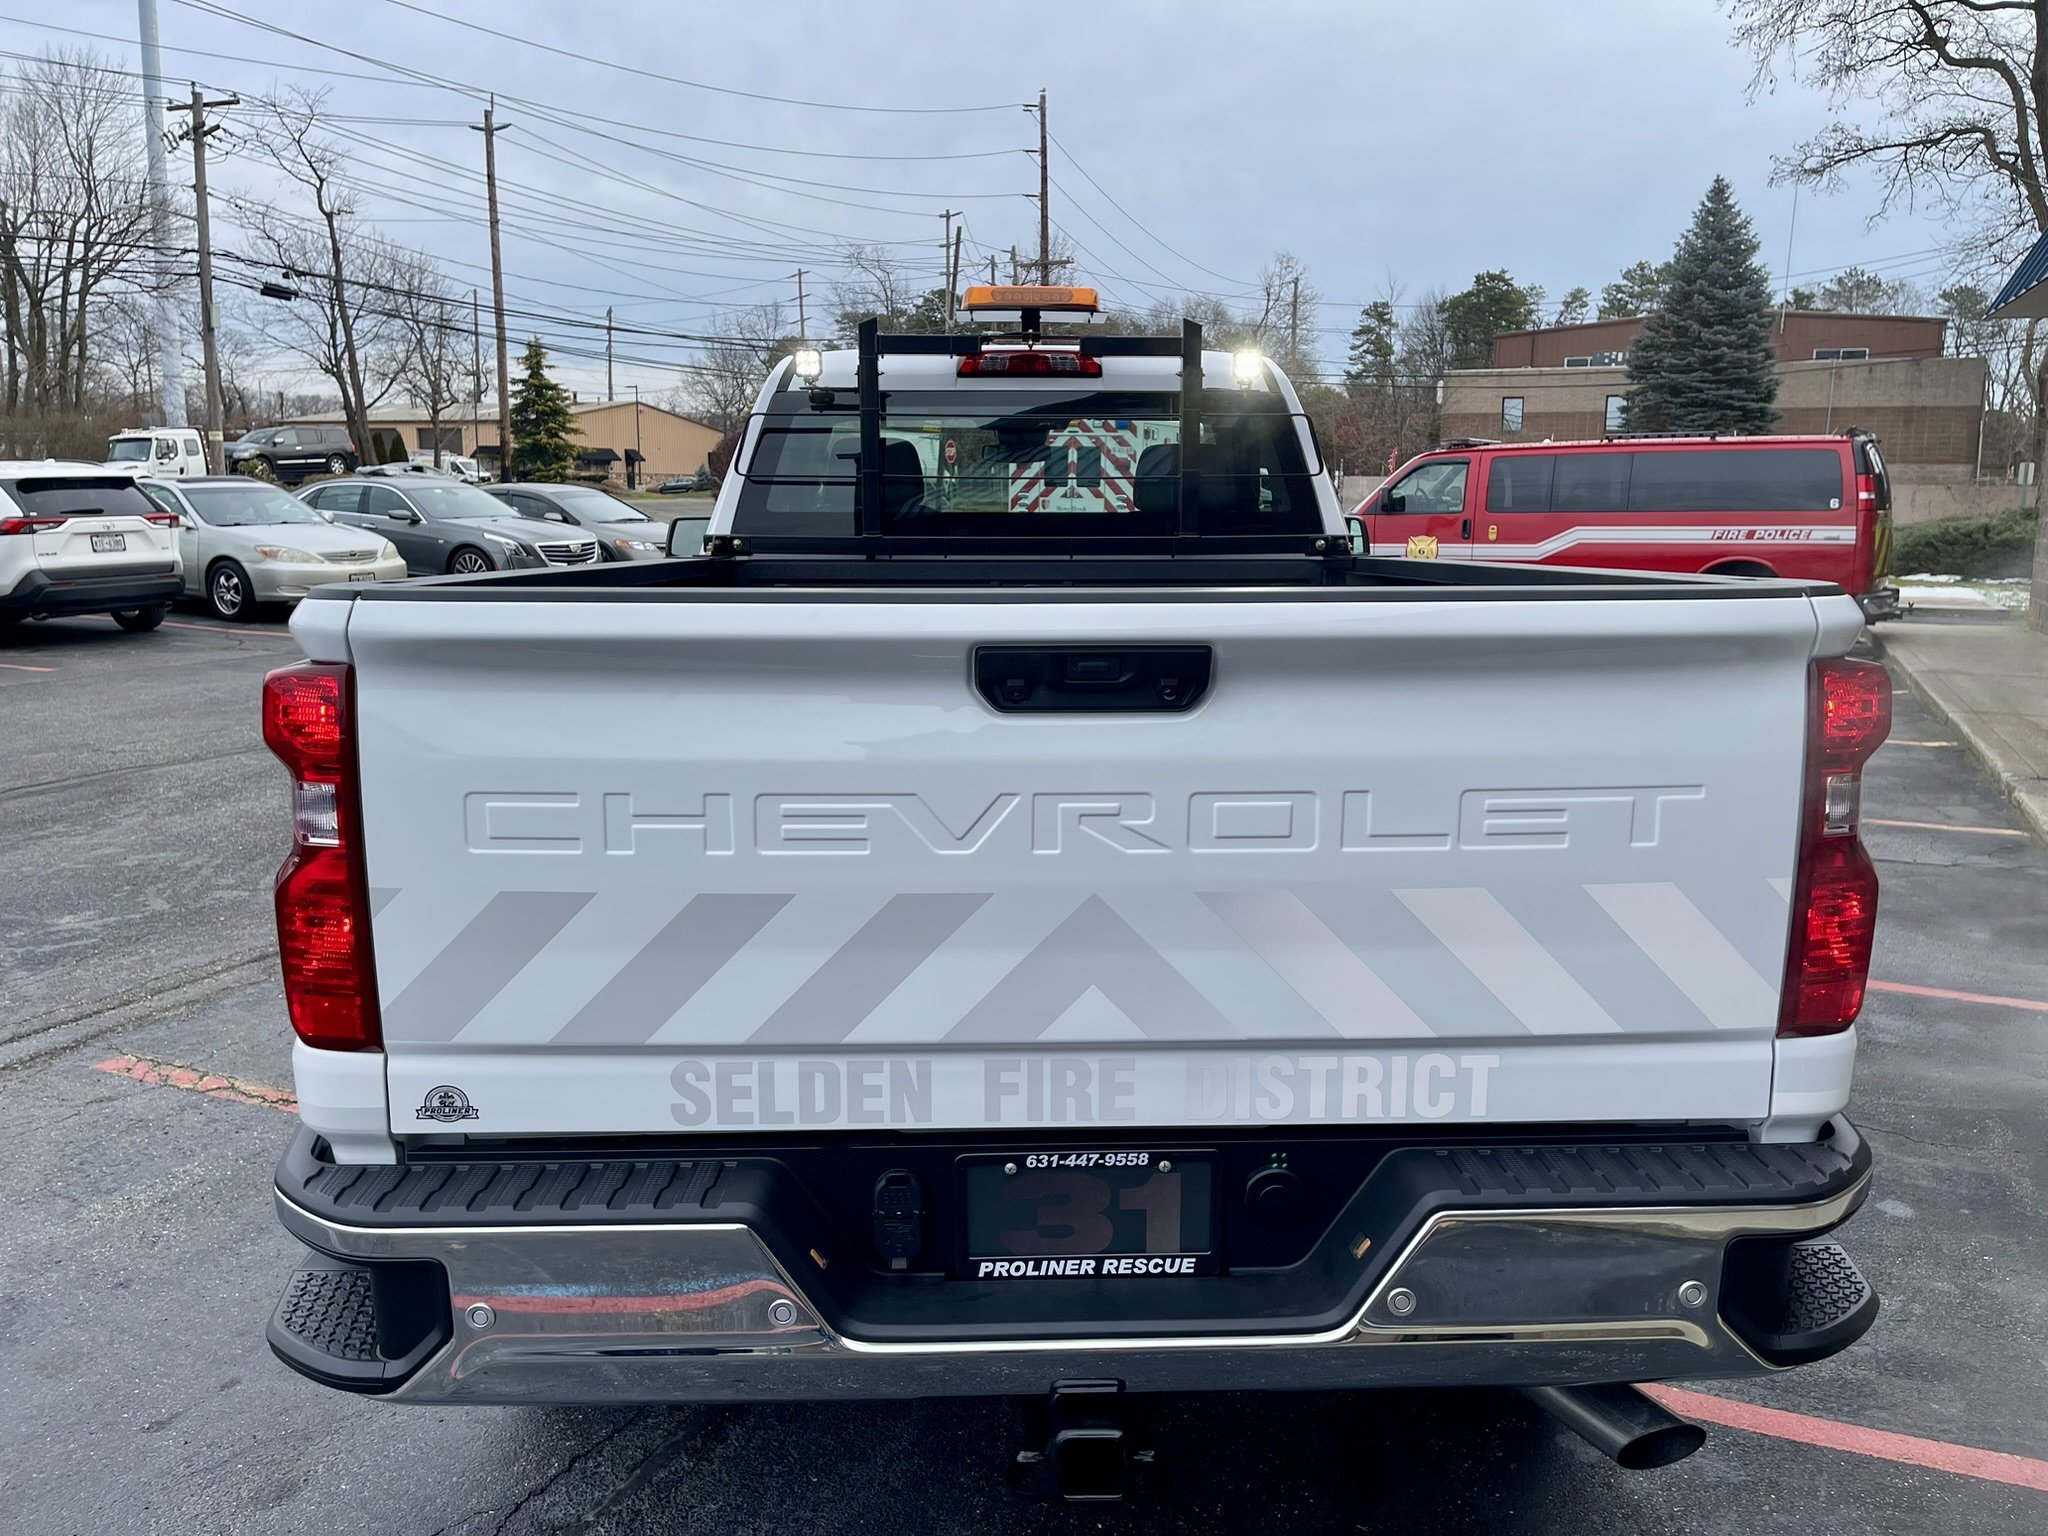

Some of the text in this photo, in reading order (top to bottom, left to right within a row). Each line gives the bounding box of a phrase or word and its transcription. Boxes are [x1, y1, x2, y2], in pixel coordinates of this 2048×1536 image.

[1712, 529, 1749, 541] FIRE
[1752, 529, 1813, 541] POLICE
[464, 784, 1706, 856] CHEVROLET
[670, 1053, 1501, 1126] SELDEN FIRE DISTRICT
[424, 1107, 470, 1115] PROLINER
[1026, 1152, 1150, 1168] 631-447-9558
[1001, 1171, 1182, 1255] 31
[977, 1257, 1197, 1278] PROLINER RESCUE
